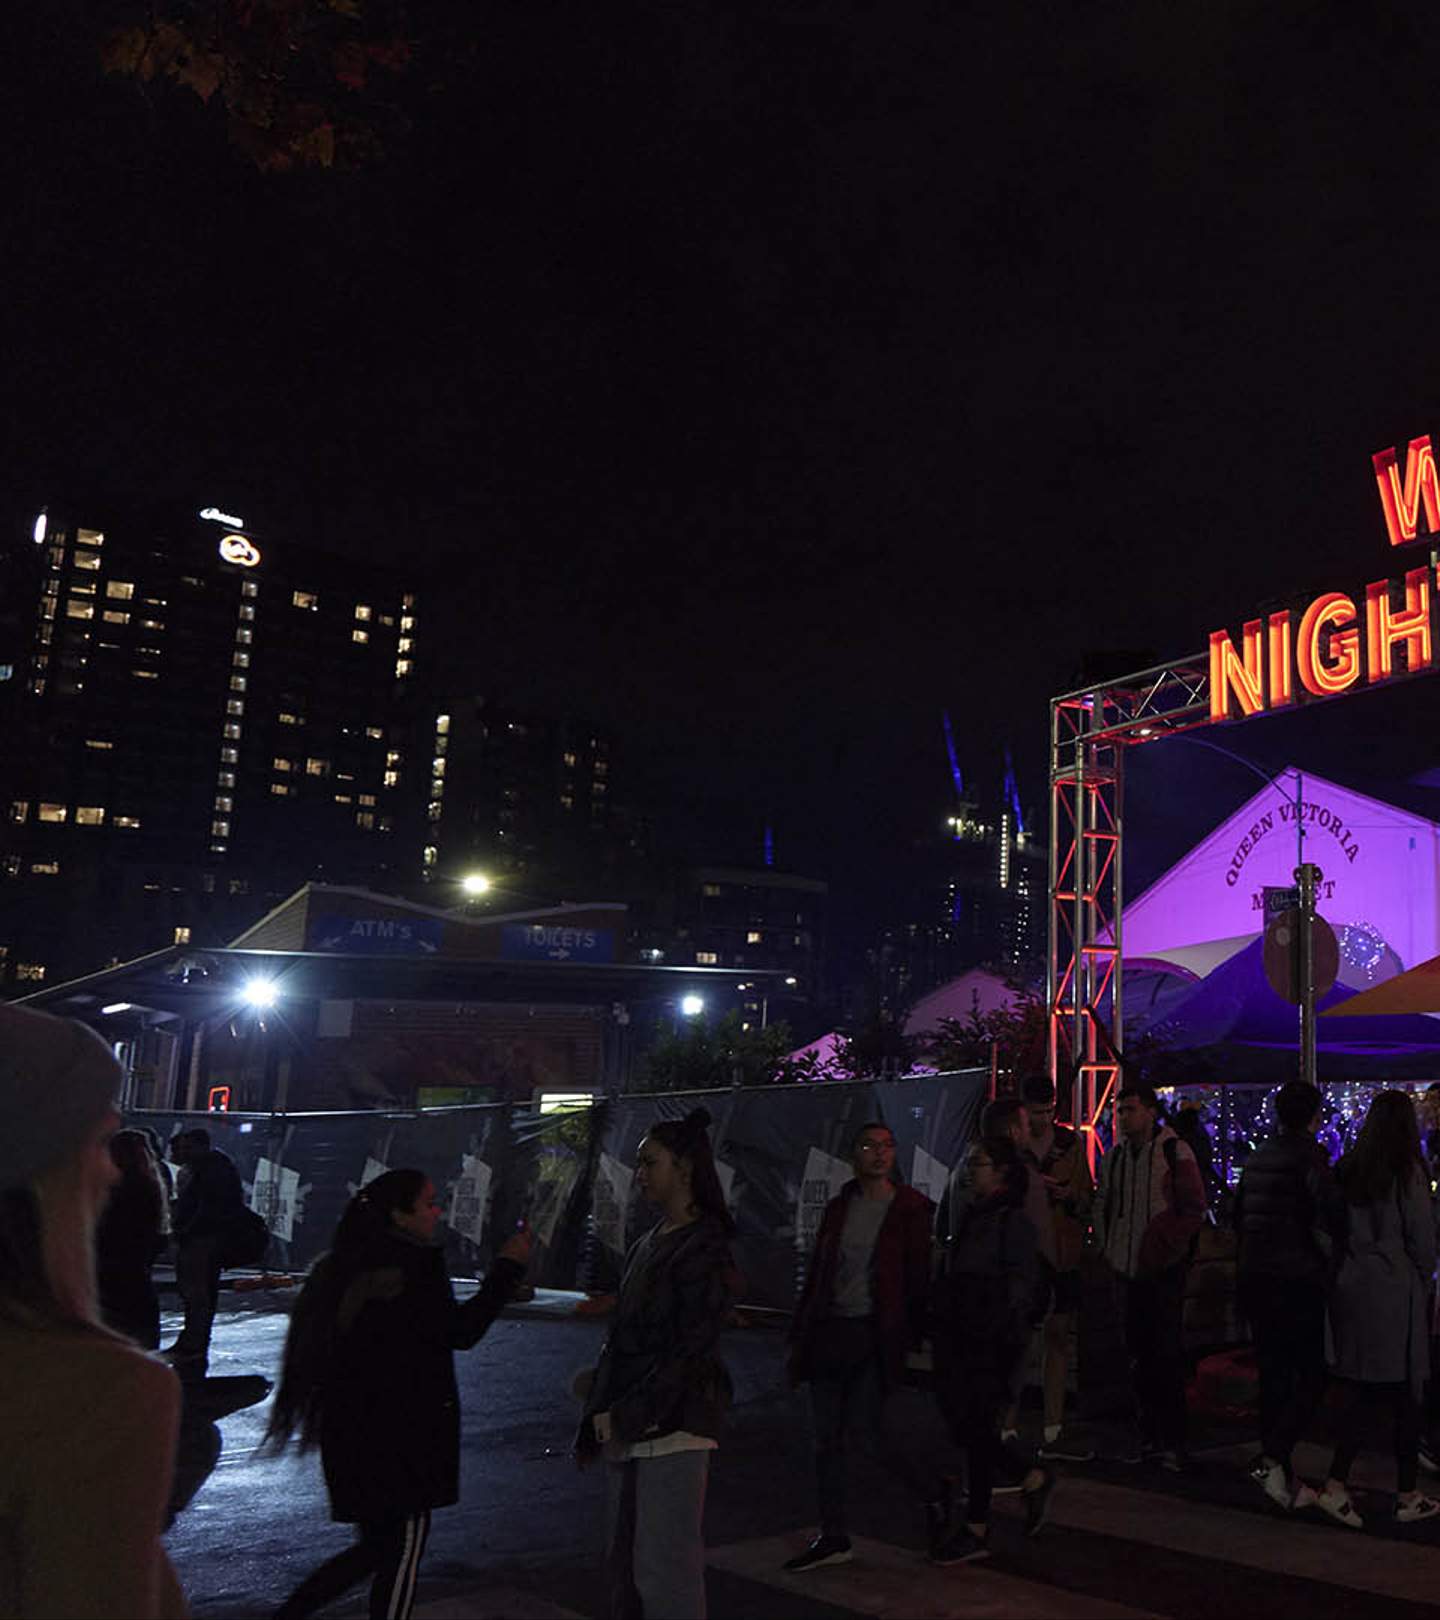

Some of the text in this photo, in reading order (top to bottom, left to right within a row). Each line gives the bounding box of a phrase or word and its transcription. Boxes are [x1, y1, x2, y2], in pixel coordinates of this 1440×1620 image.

[1226, 802, 1359, 886] QUEEN VICTORIA
[1251, 881, 1335, 911] MET
[525, 926, 597, 948] TOILETS
